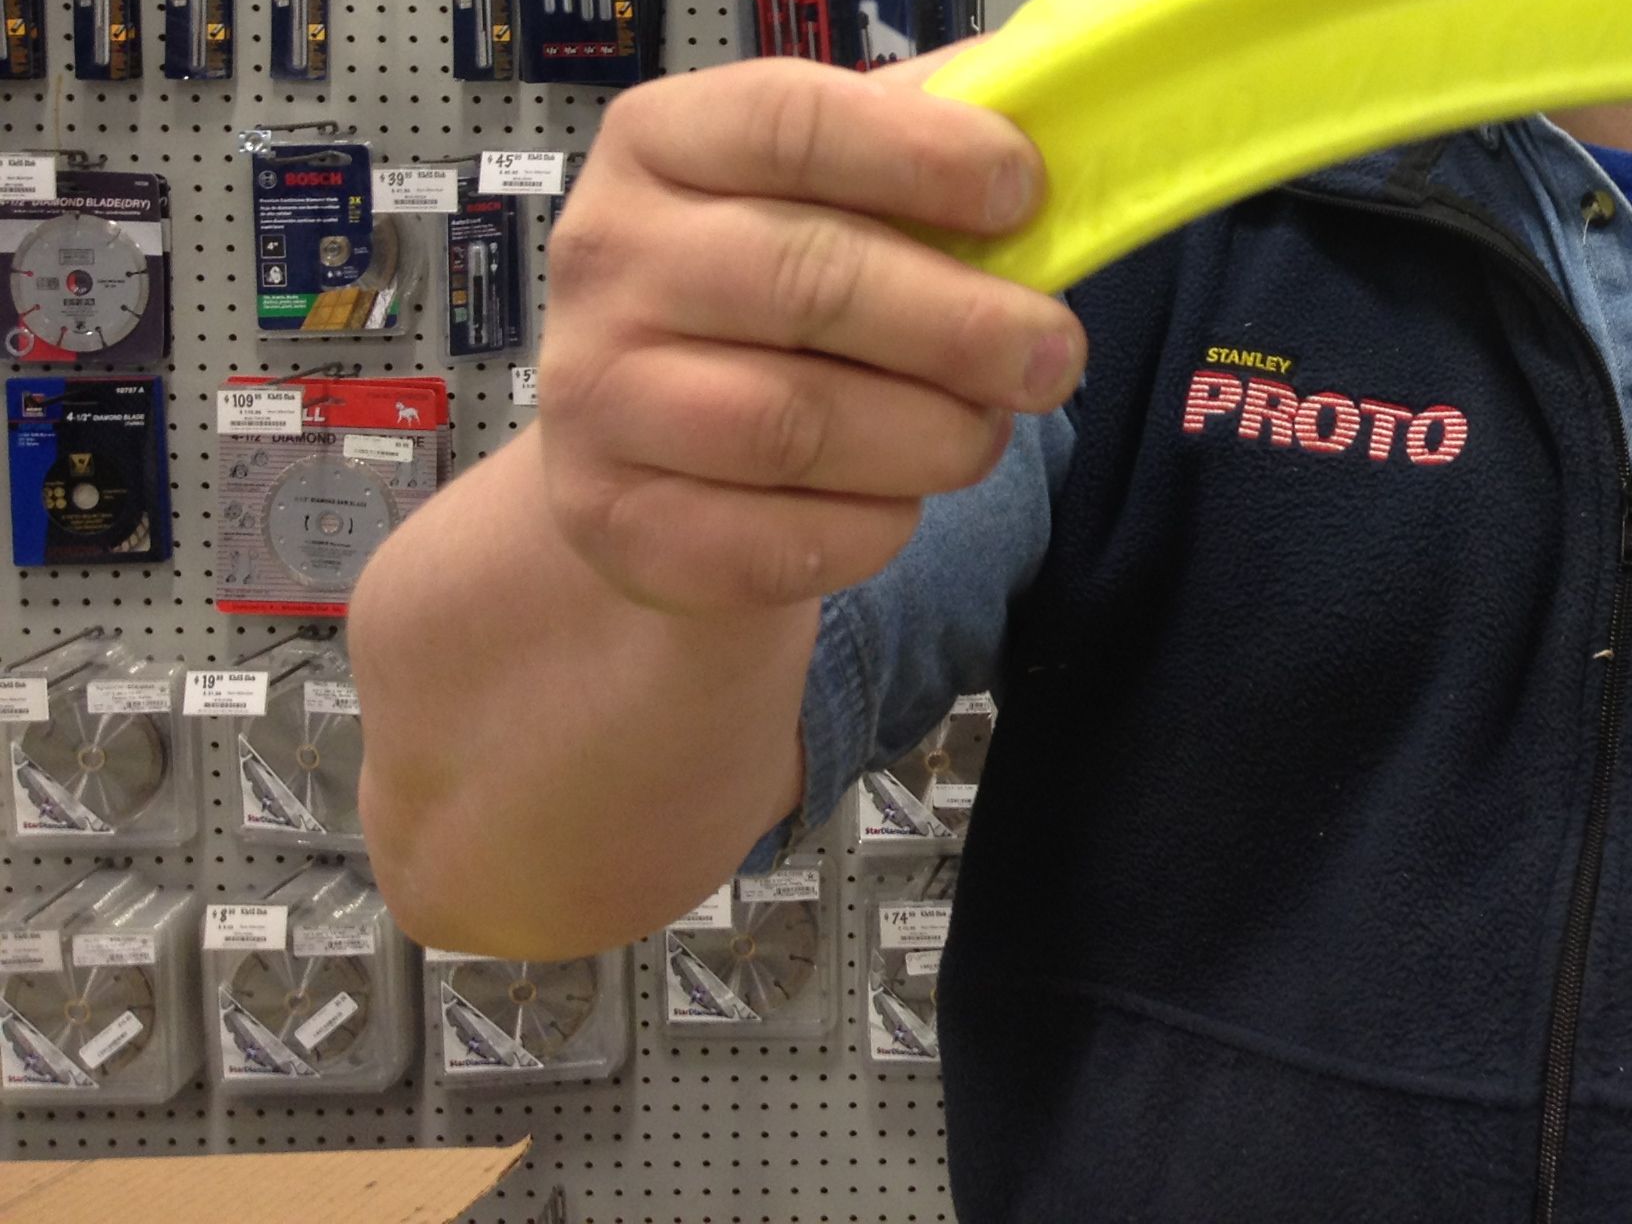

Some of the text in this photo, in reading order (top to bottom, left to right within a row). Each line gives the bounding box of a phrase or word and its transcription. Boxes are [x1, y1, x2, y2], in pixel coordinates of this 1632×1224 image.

[284, 172, 344, 186] BOSCH
[1205, 346, 1292, 374] STANLEY
[233, 393, 254, 408] 109
[1182, 369, 1468, 466] PROTO
[202, 674, 216, 689] 19
[891, 912, 909, 925] 74
